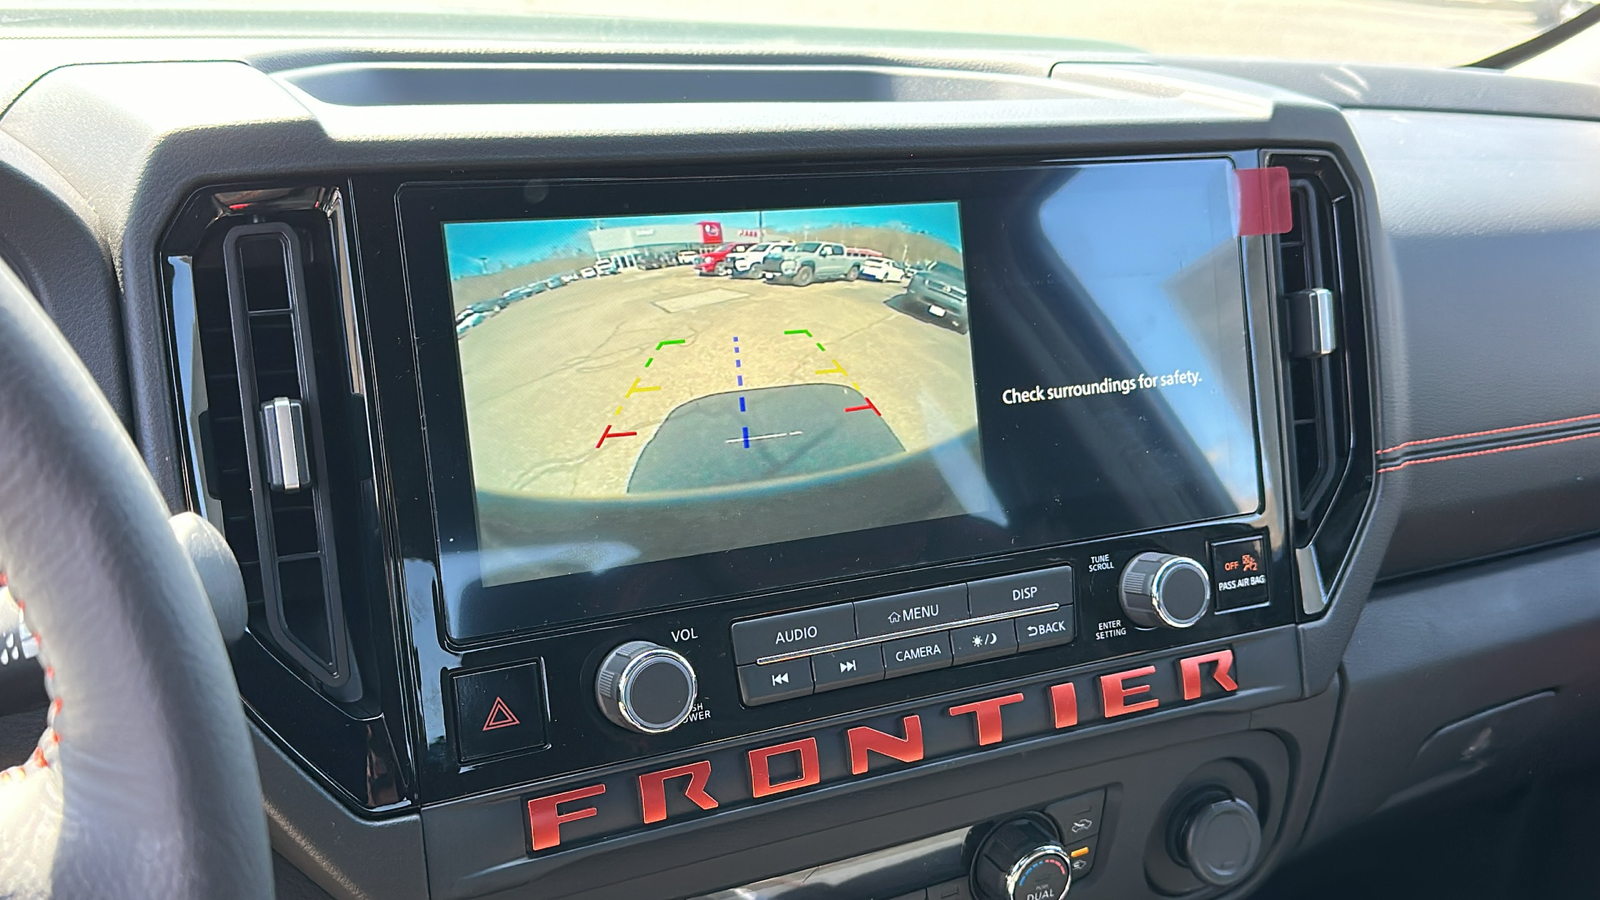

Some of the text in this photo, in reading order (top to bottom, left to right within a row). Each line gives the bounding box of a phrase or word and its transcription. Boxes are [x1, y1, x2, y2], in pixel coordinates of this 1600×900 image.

[1002, 369, 1203, 405] Check surroundings for safety.
[1090, 553, 1110, 564] TUNE
[1224, 561, 1239, 571] OFF
[1088, 561, 1115, 573] SCROLL
[1218, 574, 1266, 591] PASS AIR BAG
[1012, 586, 1039, 601] DISP
[902, 604, 939, 622] MENU
[1037, 620, 1067, 635] BACK
[1098, 619, 1122, 631] ENTER
[670, 627, 699, 643] VOL
[775, 625, 818, 645] AUDIO
[1095, 627, 1127, 641] SETTING
[895, 643, 942, 662] CAMERA
[526, 649, 1239, 852] FRONTIER
[1026, 888, 1055, 900] DUAL
